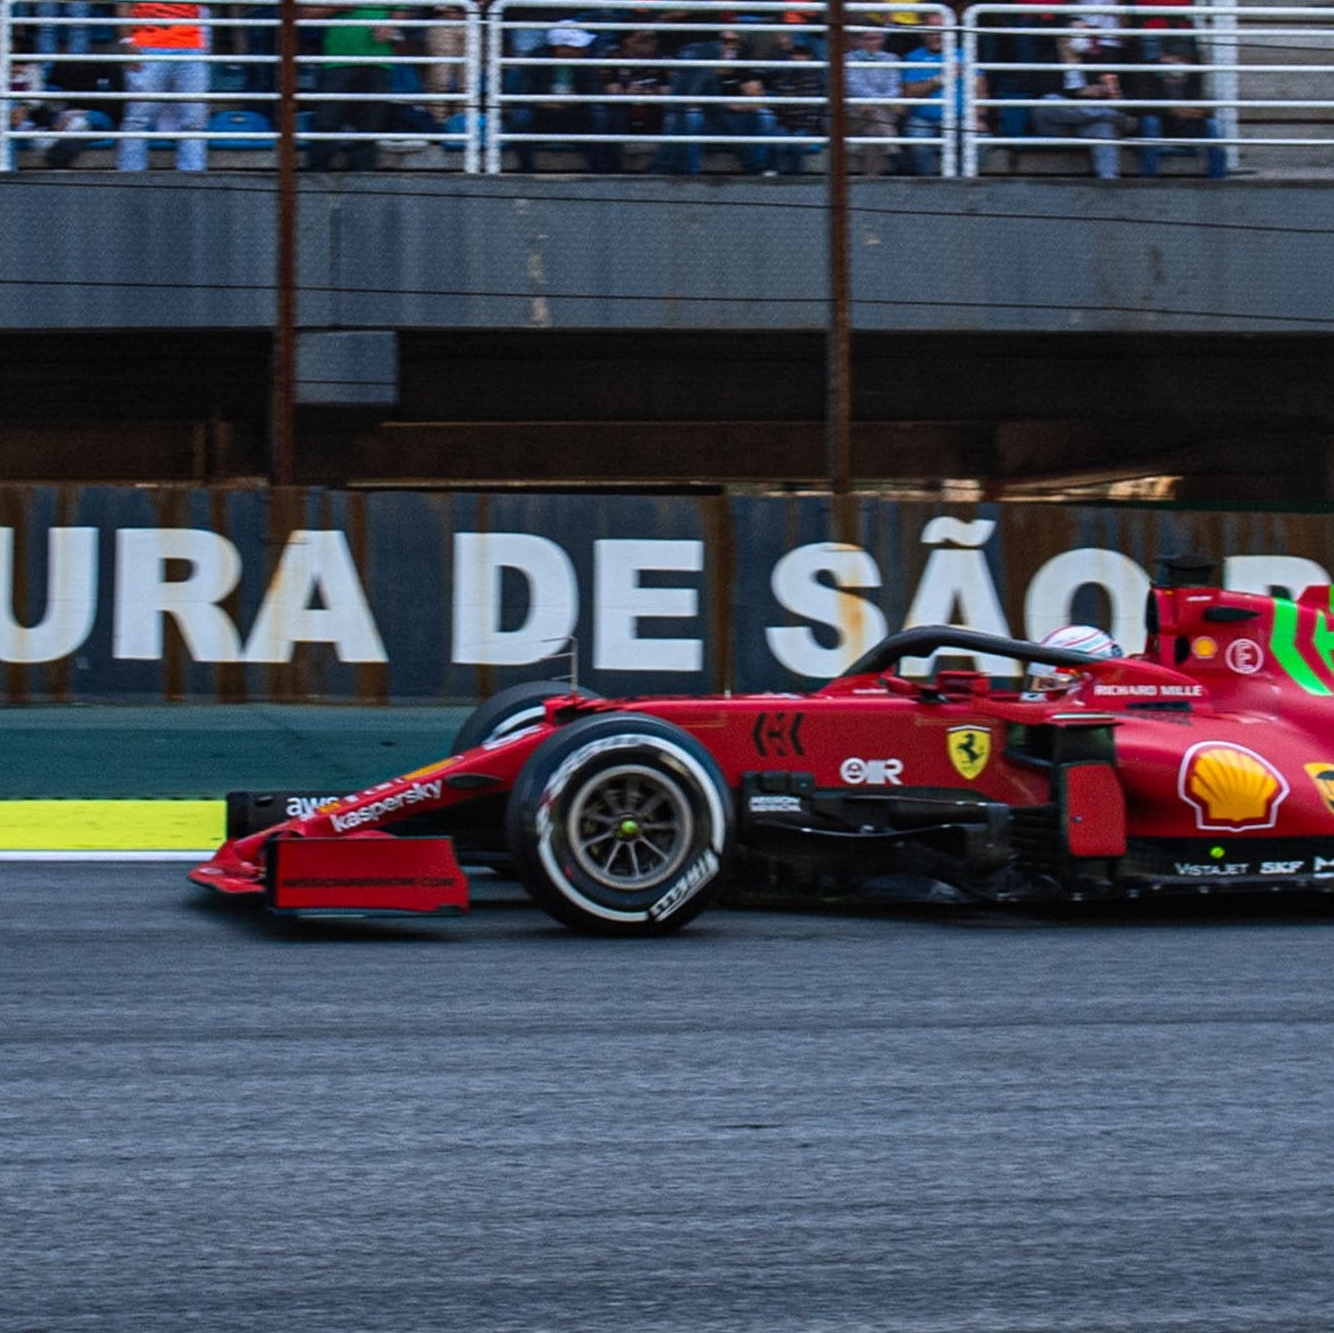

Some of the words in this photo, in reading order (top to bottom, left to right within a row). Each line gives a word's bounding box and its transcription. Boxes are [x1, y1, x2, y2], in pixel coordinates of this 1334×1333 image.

[452, 532, 704, 672] DE
[765, 516, 1154, 679] SÃO
[1094, 684, 1157, 697] RICHARD
[1160, 684, 1203, 697] MILLE
[330, 778, 443, 833] kaspersky
[1260, 861, 1305, 875] SKF
